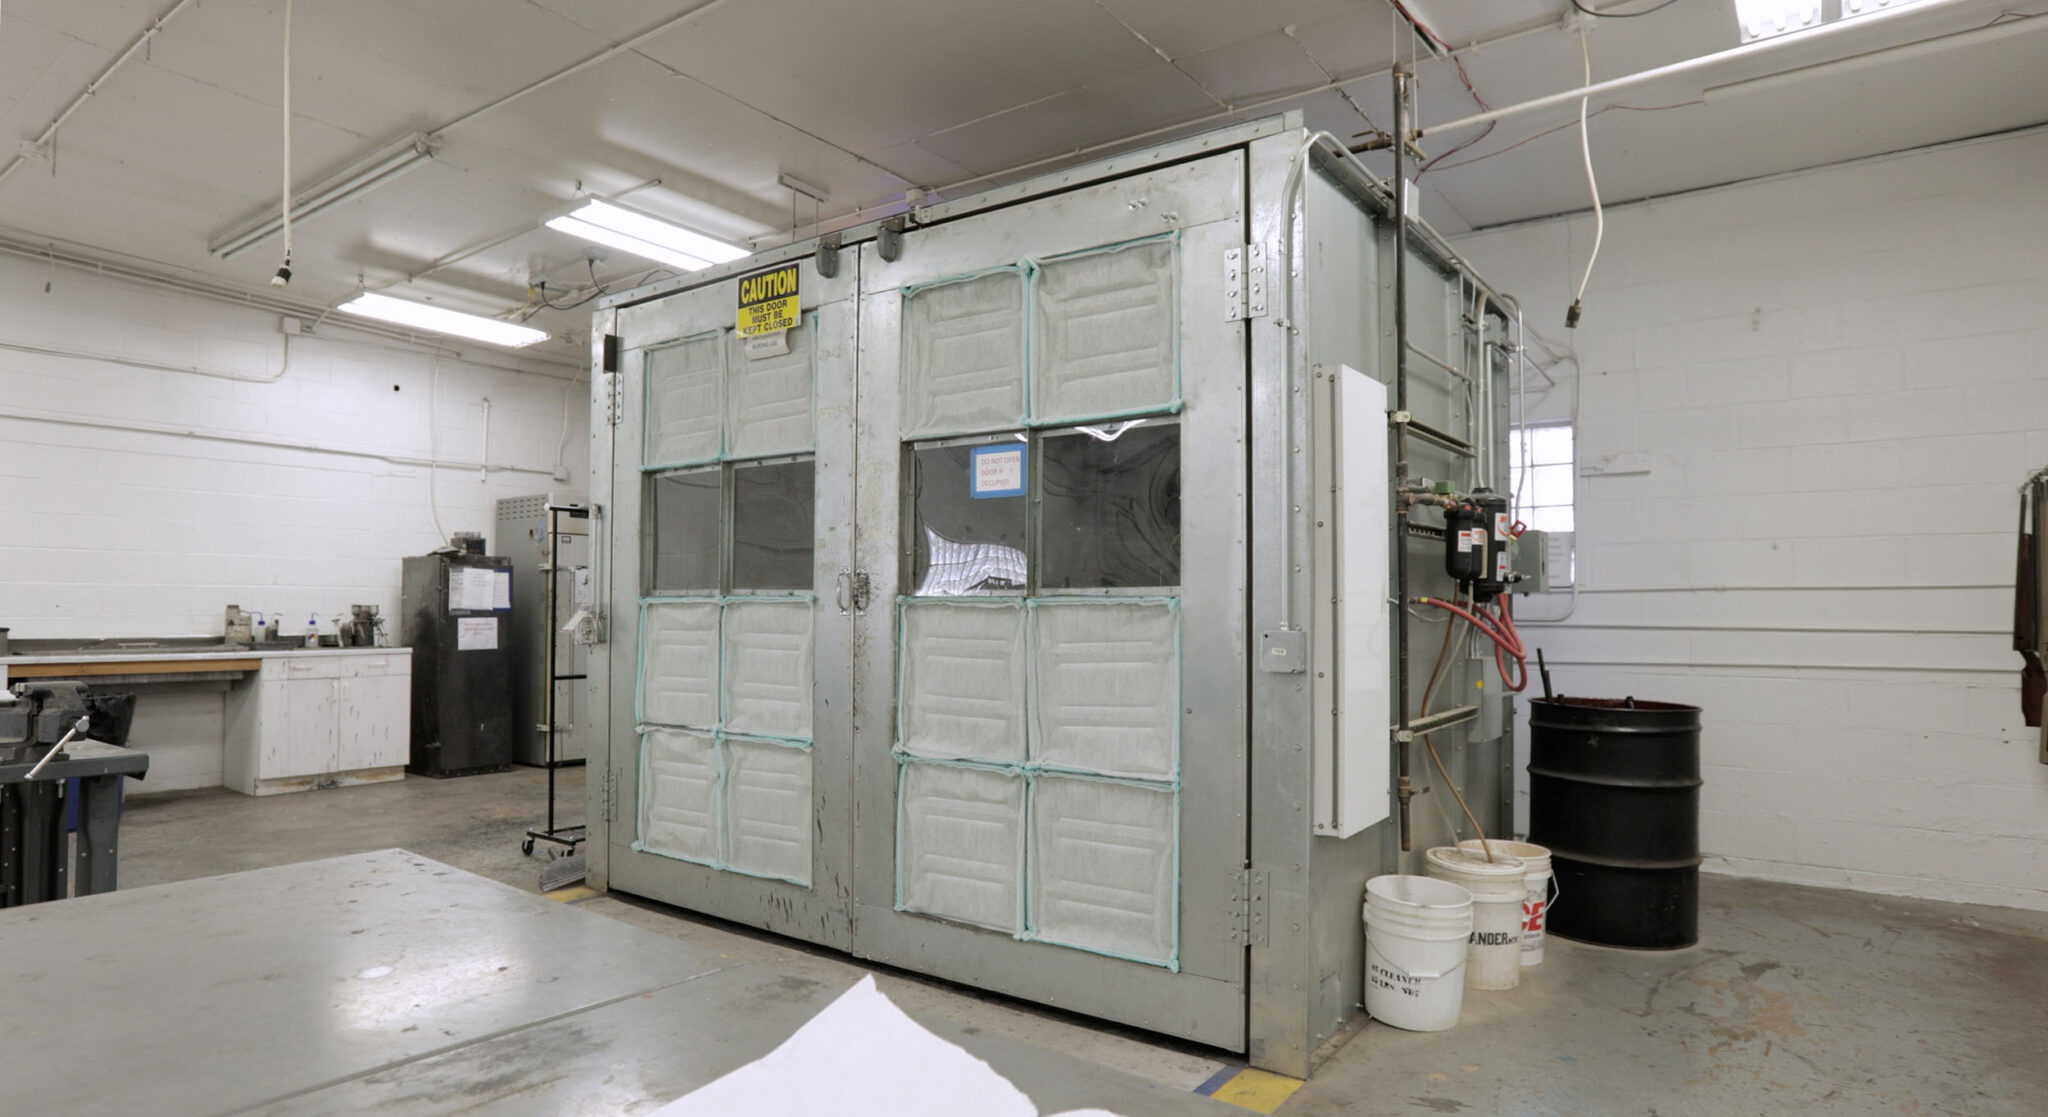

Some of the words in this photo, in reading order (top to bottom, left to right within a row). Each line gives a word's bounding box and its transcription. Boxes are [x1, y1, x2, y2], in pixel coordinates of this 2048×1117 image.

[741, 268, 797, 304] CAUTION
[749, 304, 764, 316] THIS
[767, 299, 787, 311] DOOR
[752, 312, 771, 324] MUST
[774, 310, 783, 319] BE
[743, 324, 761, 335] KEPT
[764, 317, 793, 331] CLOSED
[991, 456, 1003, 464] NOT
[1004, 455, 1020, 463] OPEN
